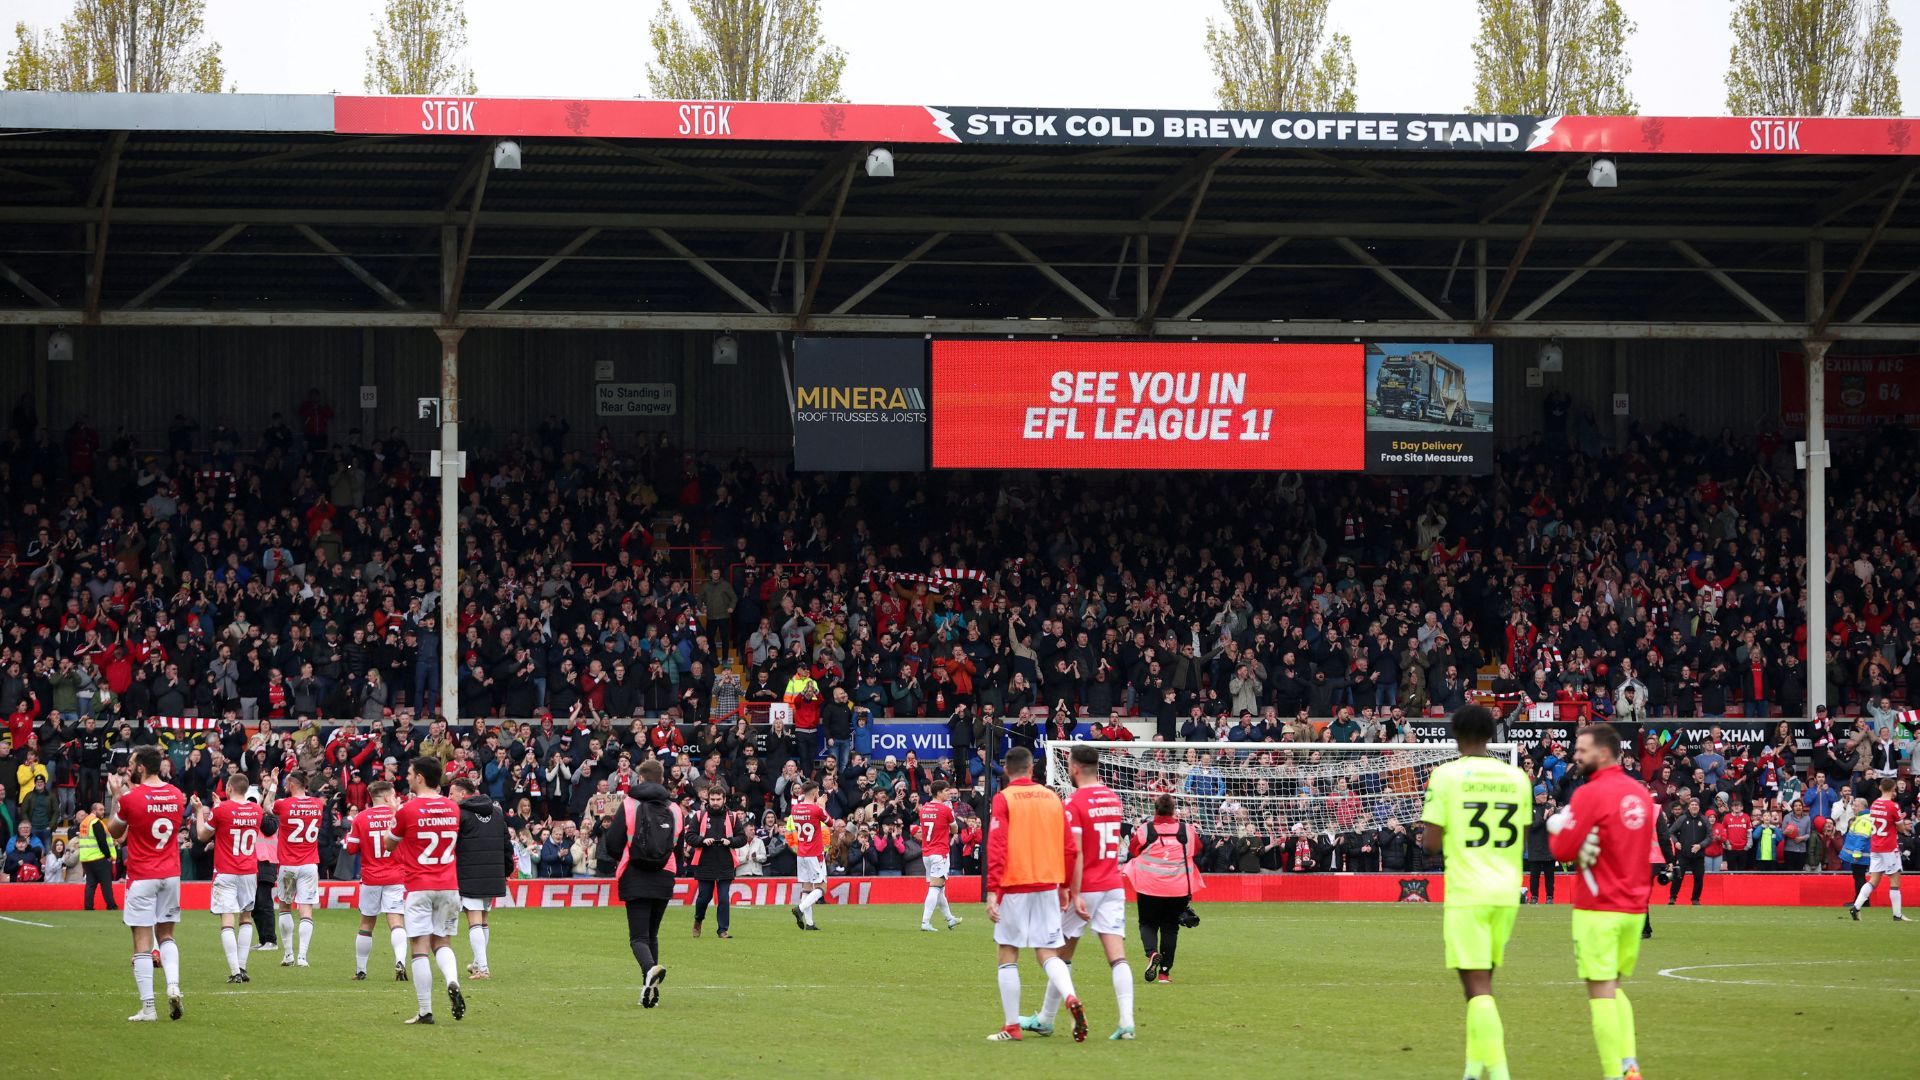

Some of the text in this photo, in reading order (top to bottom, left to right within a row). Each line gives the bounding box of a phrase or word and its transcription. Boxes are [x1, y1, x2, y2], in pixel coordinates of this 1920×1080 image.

[1065, 115, 1155, 137] COLD
[1163, 117, 1265, 139] BREW
[1271, 118, 1398, 141] COFFEE
[1406, 120, 1519, 143] STAND
[1824, 358, 1904, 372] EXHAM AFC
[600, 387, 673, 400] No Standing in
[1049, 371, 1247, 404] SEE YOU IN
[362, 392, 375, 401] U3
[797, 386, 908, 410] MINERA
[601, 401, 672, 413] Rear Gangway
[797, 411, 927, 423] ROOF TRUSSES & JOISTS
[1023, 407, 1273, 441] EFL LEAGUE 1!
[1392, 441, 1463, 453] 5 Day Delivery
[1381, 453, 1474, 462] Free Site Measures
[774, 710, 786, 719] L3
[1539, 709, 1551, 719] L4
[1508, 728, 1533, 739] 300
[1686, 728, 1765, 742] WRXHAM
[871, 733, 907, 749] FOR
[147, 803, 179, 813] PALMER
[233, 818, 257, 826] MULLIN
[417, 816, 458, 827] O'CONNOR
[1464, 802, 1518, 848] 33
[151, 817, 173, 849] 9
[287, 818, 320, 843] 26
[794, 822, 815, 842] 29
[923, 821, 935, 842] 7
[230, 828, 258, 856] 10
[1093, 822, 1121, 857] 15
[417, 831, 458, 865] 22
